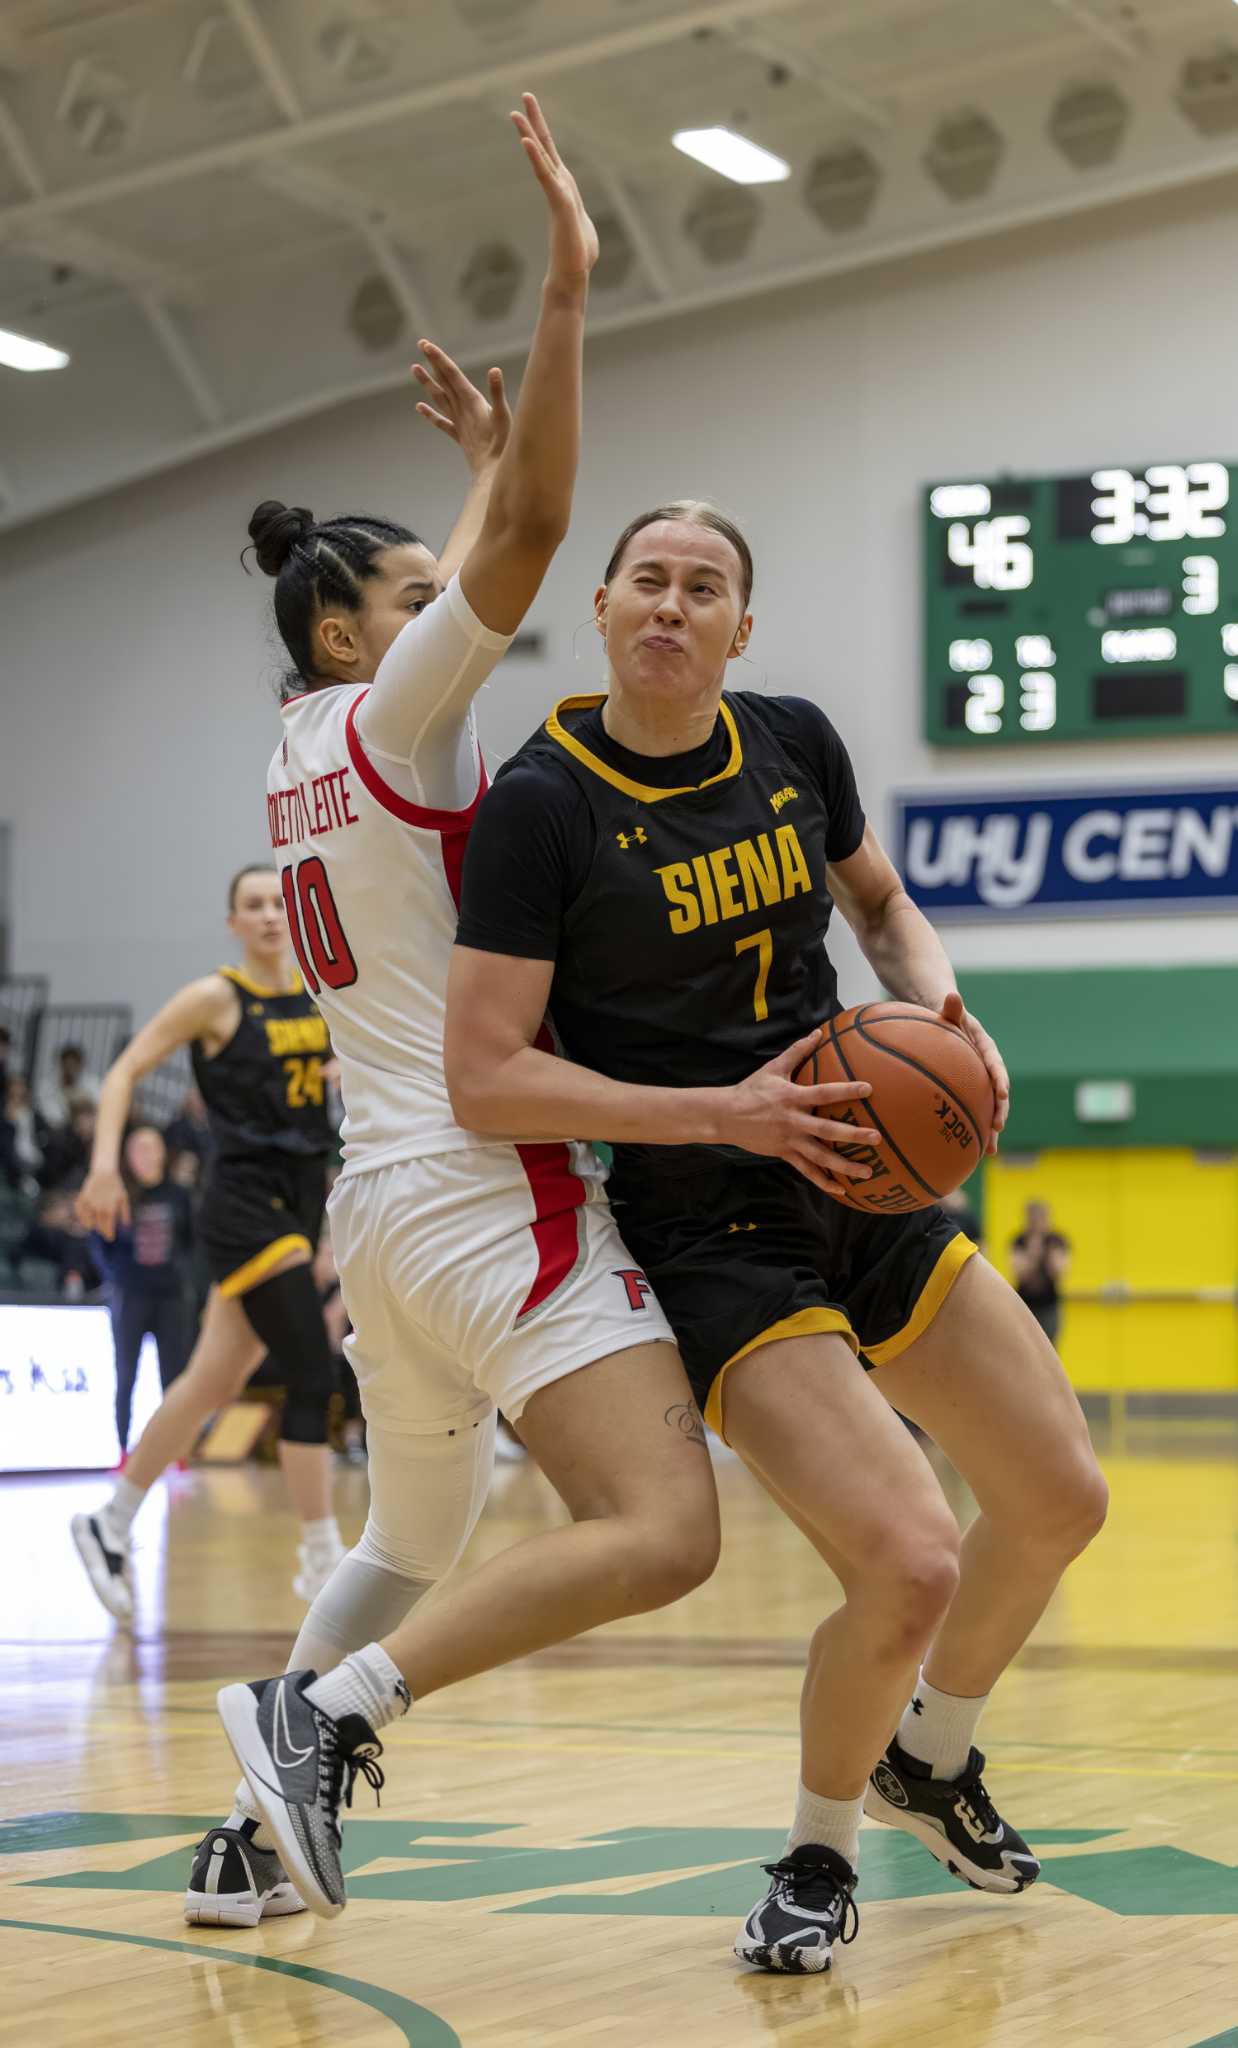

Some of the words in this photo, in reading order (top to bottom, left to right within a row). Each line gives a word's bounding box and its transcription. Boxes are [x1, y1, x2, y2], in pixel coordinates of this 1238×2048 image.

[1091, 463, 1229, 544] 3:32
[948, 516, 1033, 591] 46
[1182, 555, 1218, 615] 3
[965, 674, 1004, 734] 2
[1020, 671, 1056, 731] 3
[653, 824, 813, 935] SIENA
[282, 856, 358, 995] 10
[735, 928, 773, 1022] 7
[284, 1057, 324, 1108] 24
[934, 1100, 973, 1149] ROCK
[611, 1269, 651, 1311] F
